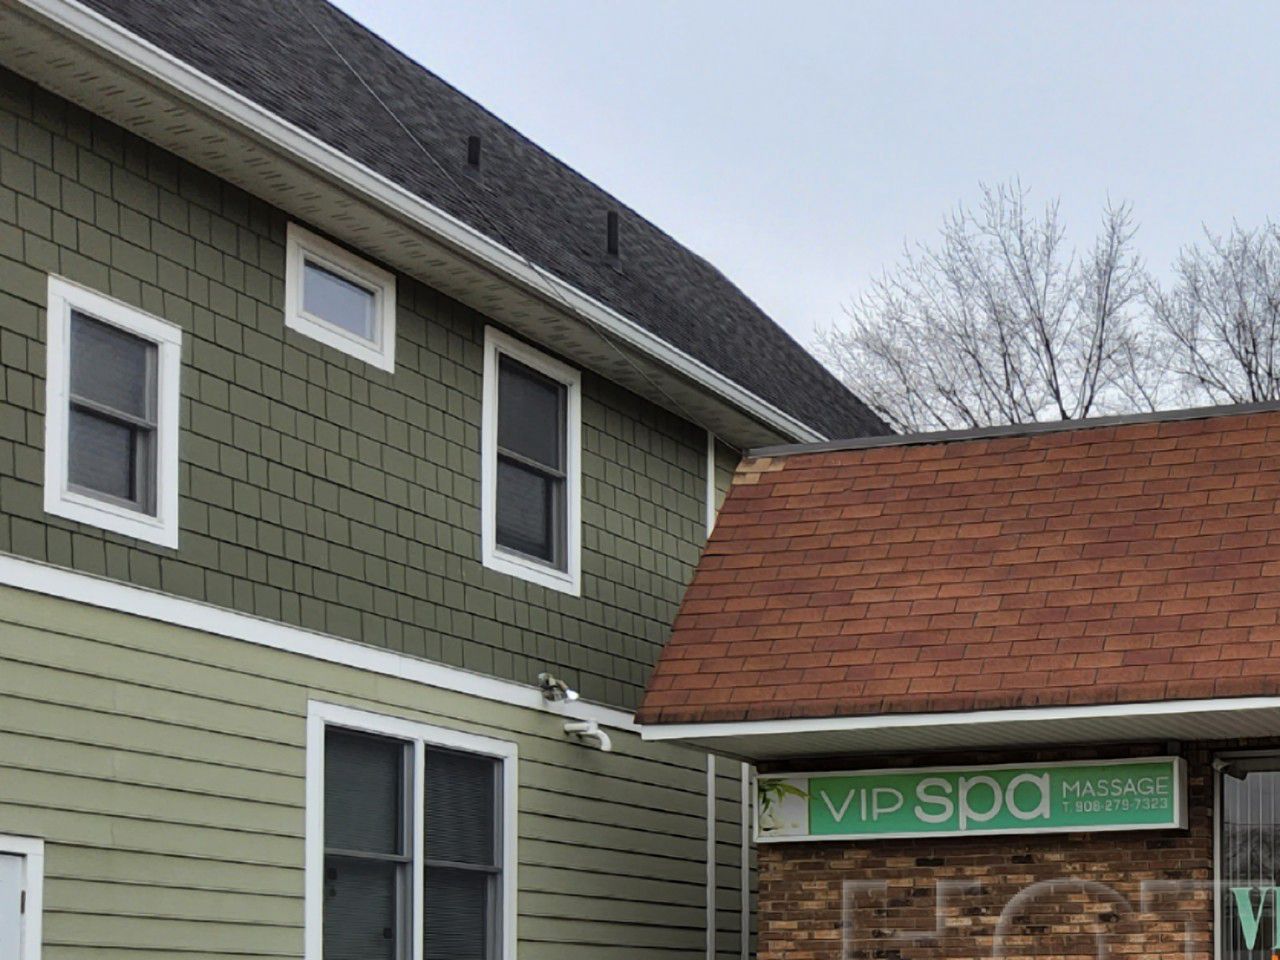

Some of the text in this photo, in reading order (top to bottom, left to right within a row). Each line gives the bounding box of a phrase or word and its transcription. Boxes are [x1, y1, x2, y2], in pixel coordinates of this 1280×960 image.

[820, 772, 1051, 832] VIP spa
[1062, 776, 1169, 798] MASSAGE
